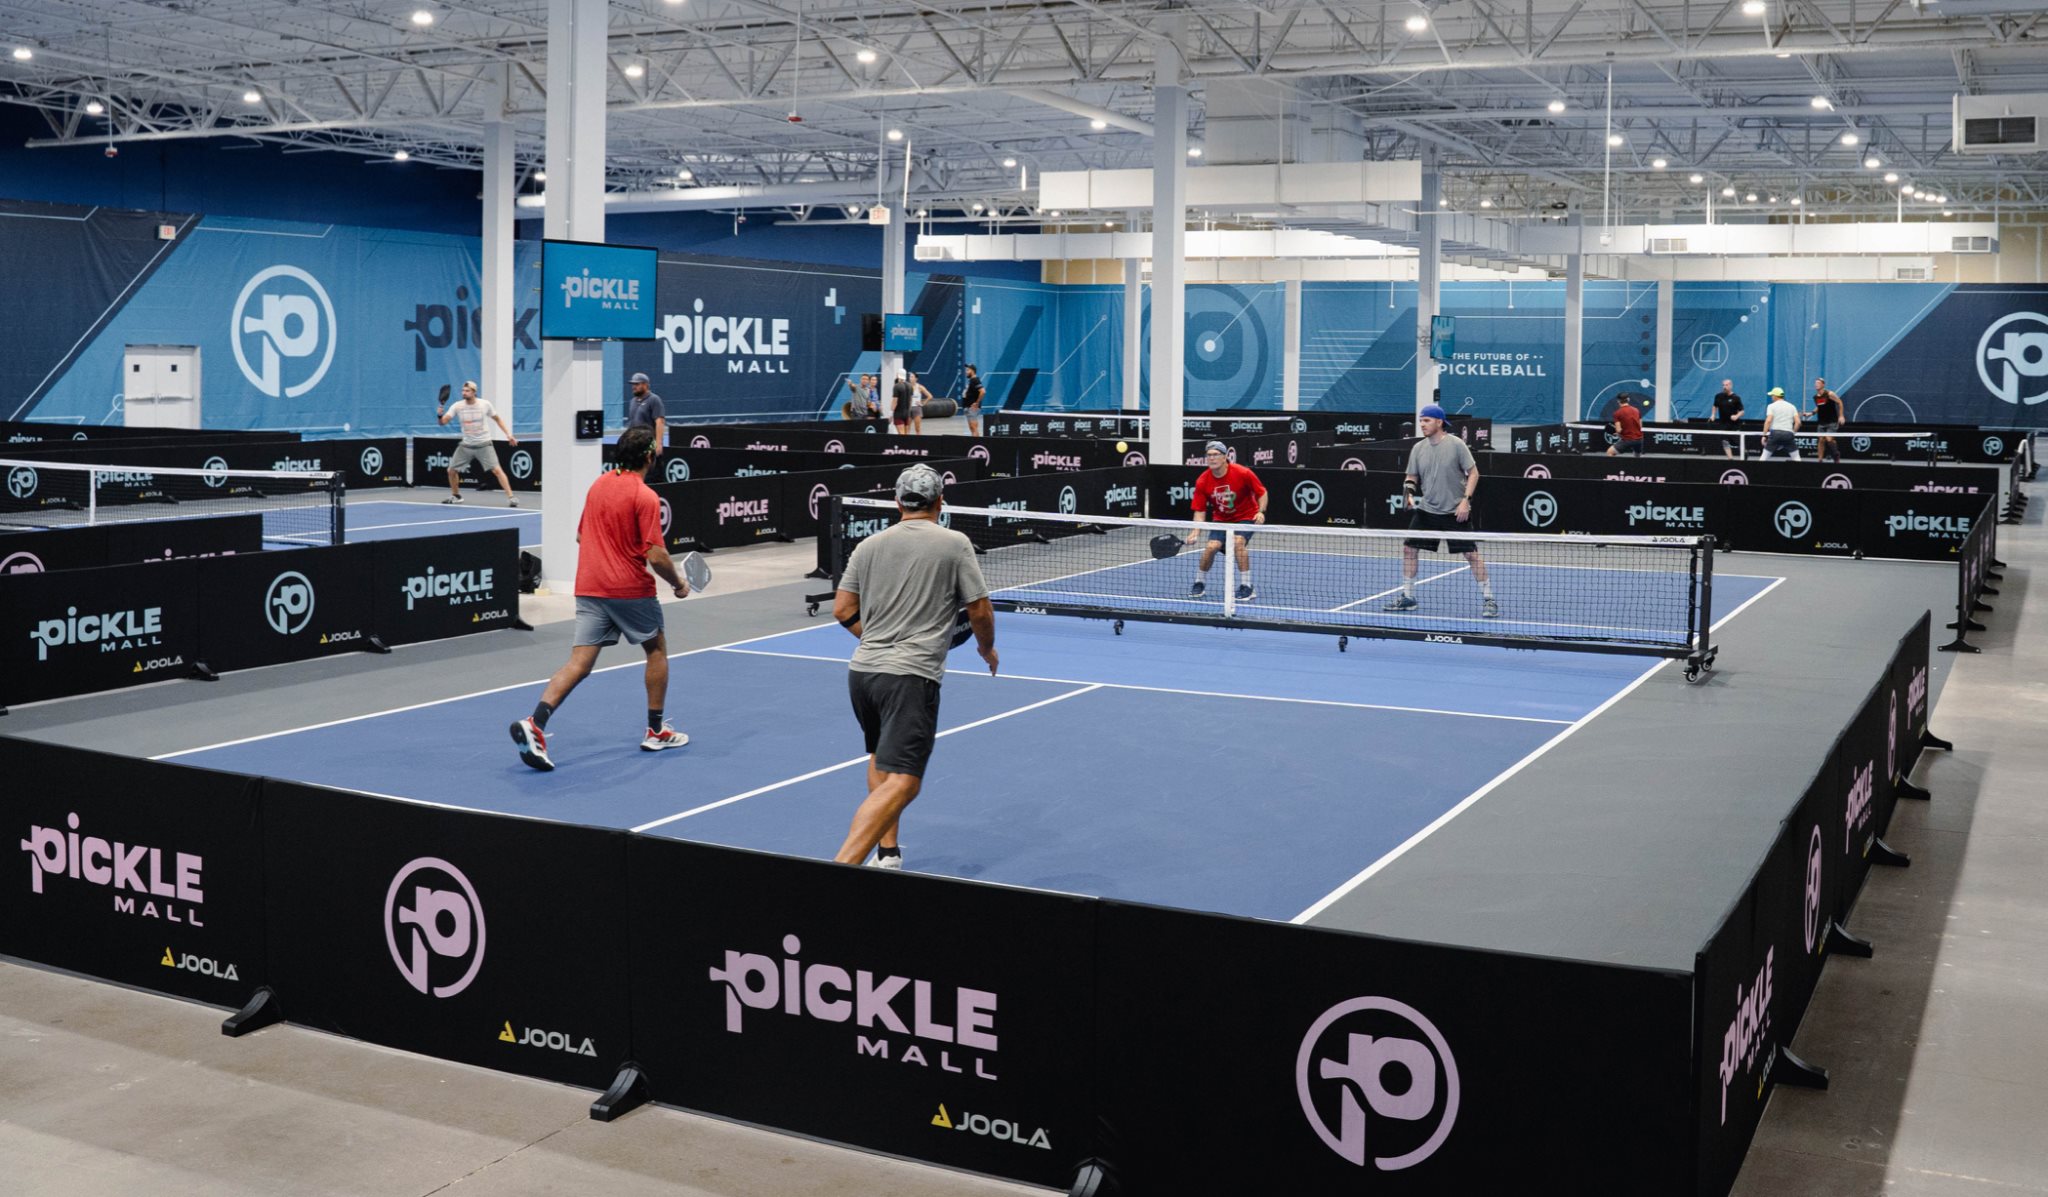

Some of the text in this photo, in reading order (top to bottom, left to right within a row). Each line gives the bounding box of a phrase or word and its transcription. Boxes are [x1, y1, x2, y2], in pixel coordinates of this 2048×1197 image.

[601, 301, 639, 310] MALL
[404, 285, 539, 372] piK
[1453, 352, 1530, 361] THE FUTURE OF
[512, 357, 543, 372] MA
[728, 359, 790, 374] MALL
[1438, 363, 1547, 377] PICKLEBALL
[1794, 438, 1817, 446] CKLE
[743, 515, 768, 523] MALL
[450, 592, 493, 605] MALL
[479, 609, 508, 621] JOOLA
[329, 630, 361, 642] JOOLA
[1432, 634, 1463, 644] JOOLA
[101, 636, 162, 652] MALL
[144, 655, 183, 671] JOOLA
[114, 896, 204, 927] MALL
[176, 953, 239, 981] JOOLA
[518, 1027, 598, 1057] JOOLA
[1746, 1010, 1772, 1075] MALL
[857, 1035, 998, 1081] MALL
[955, 1111, 1052, 1150] JOOLA
